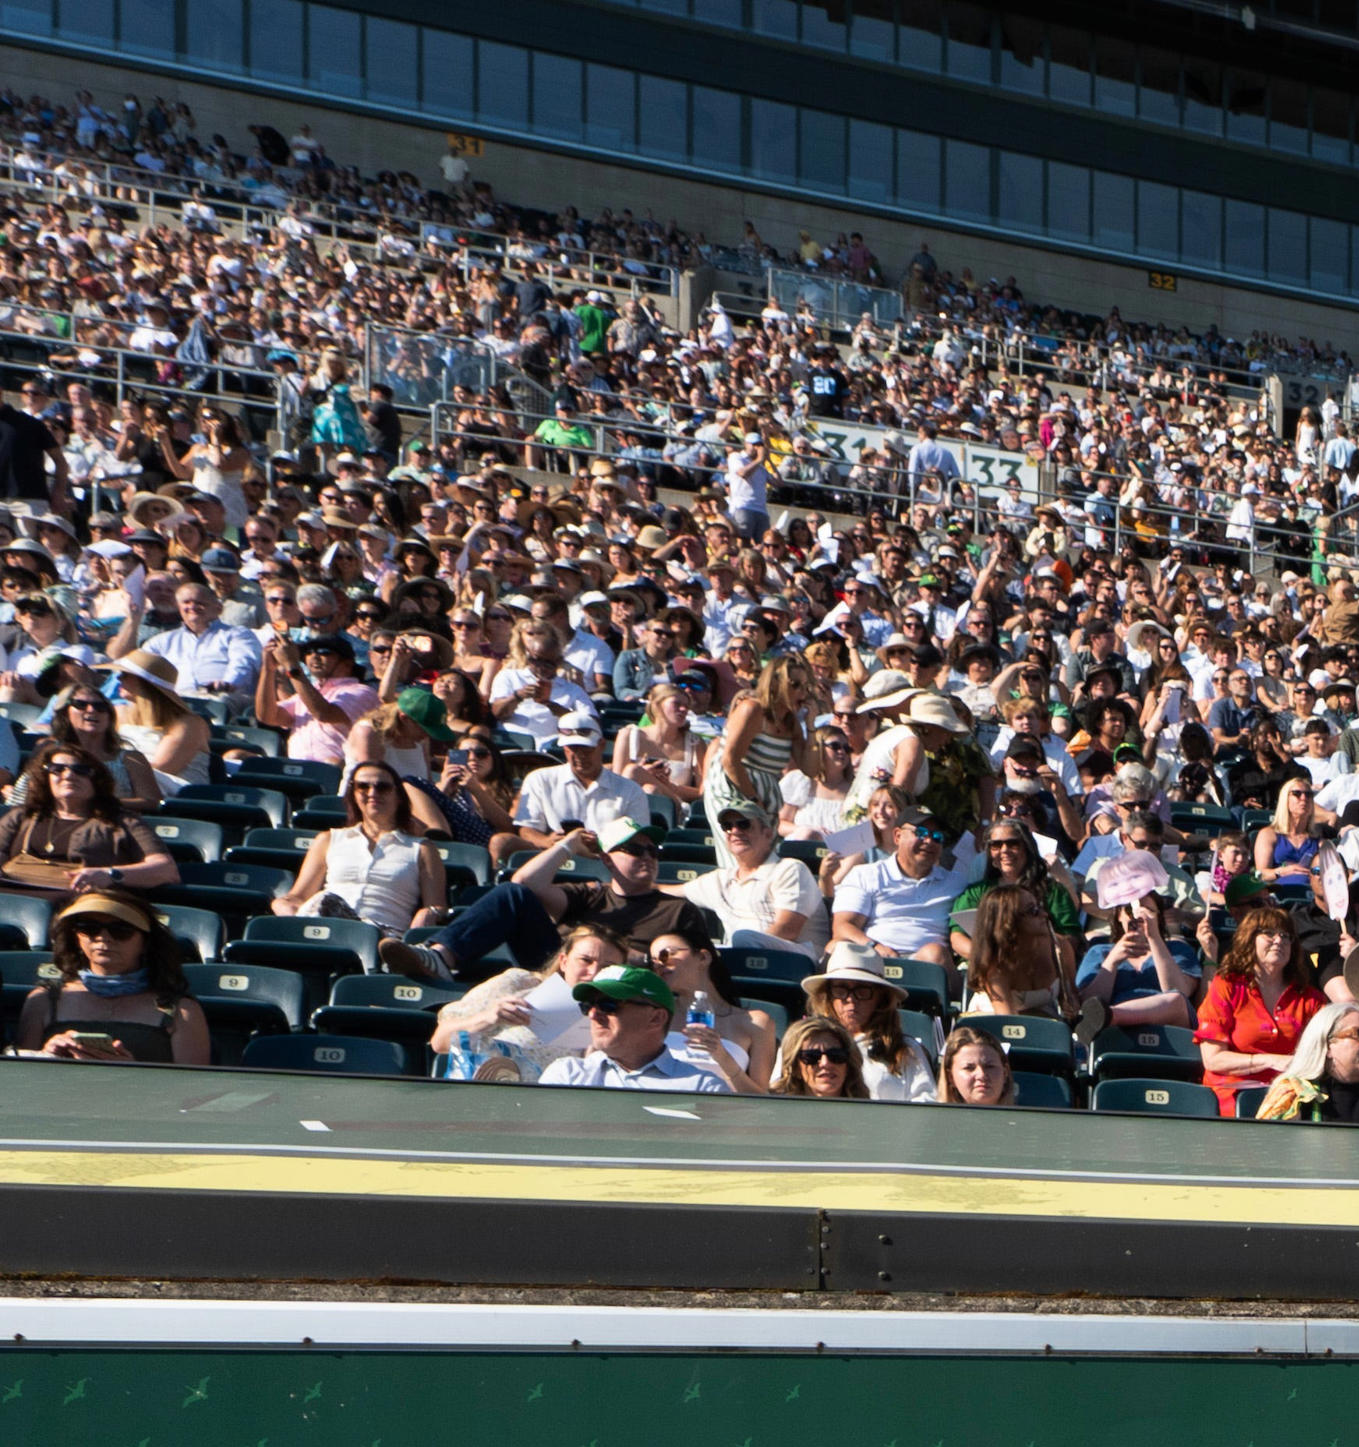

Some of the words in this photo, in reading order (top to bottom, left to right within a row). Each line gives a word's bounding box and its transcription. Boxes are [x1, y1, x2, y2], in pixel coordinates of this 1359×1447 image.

[1151, 272, 1175, 291] 32
[1288, 380, 1319, 405] 32
[320, 1050, 340, 1061] 10
